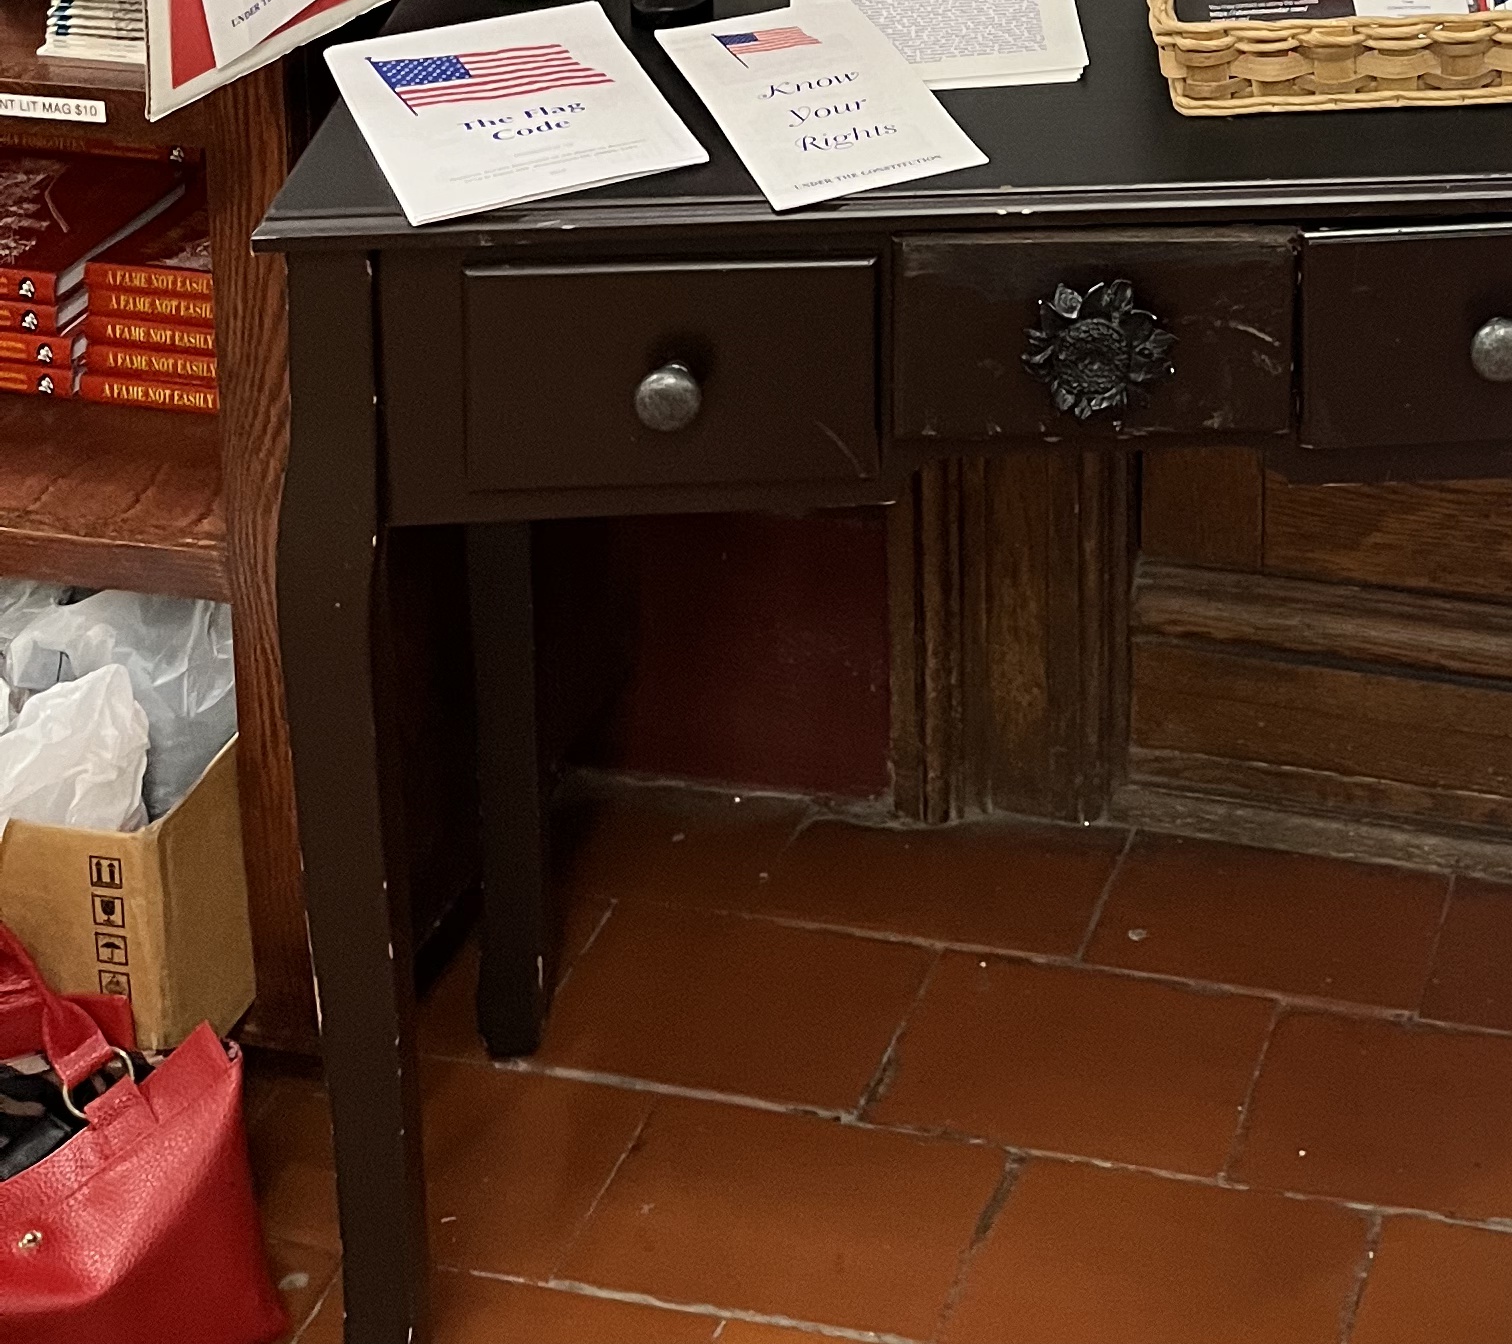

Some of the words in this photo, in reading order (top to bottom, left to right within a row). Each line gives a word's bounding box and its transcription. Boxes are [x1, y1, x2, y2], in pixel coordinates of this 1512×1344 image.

[757, 71, 860, 100] Know
[19, 100, 38, 112] LIT
[42, 103, 72, 114] MAG
[75, 104, 98, 117] $10
[458, 115, 513, 131] The
[523, 101, 586, 119] Flag
[492, 118, 572, 141] Code
[794, 123, 898, 152] Rights
[106, 324, 114, 338] A
[115, 325, 146, 342] FAME
[150, 330, 173, 345] NOT
[175, 332, 215, 349] EASILY
[108, 352, 116, 367] A
[117, 353, 148, 371] FAME
[150, 358, 174, 374] NOT
[177, 360, 217, 378] EASILY
[103, 383, 111, 398] A
[113, 383, 145, 402] FAME
[148, 387, 172, 404] NOT
[173, 389, 215, 408] EASILY
